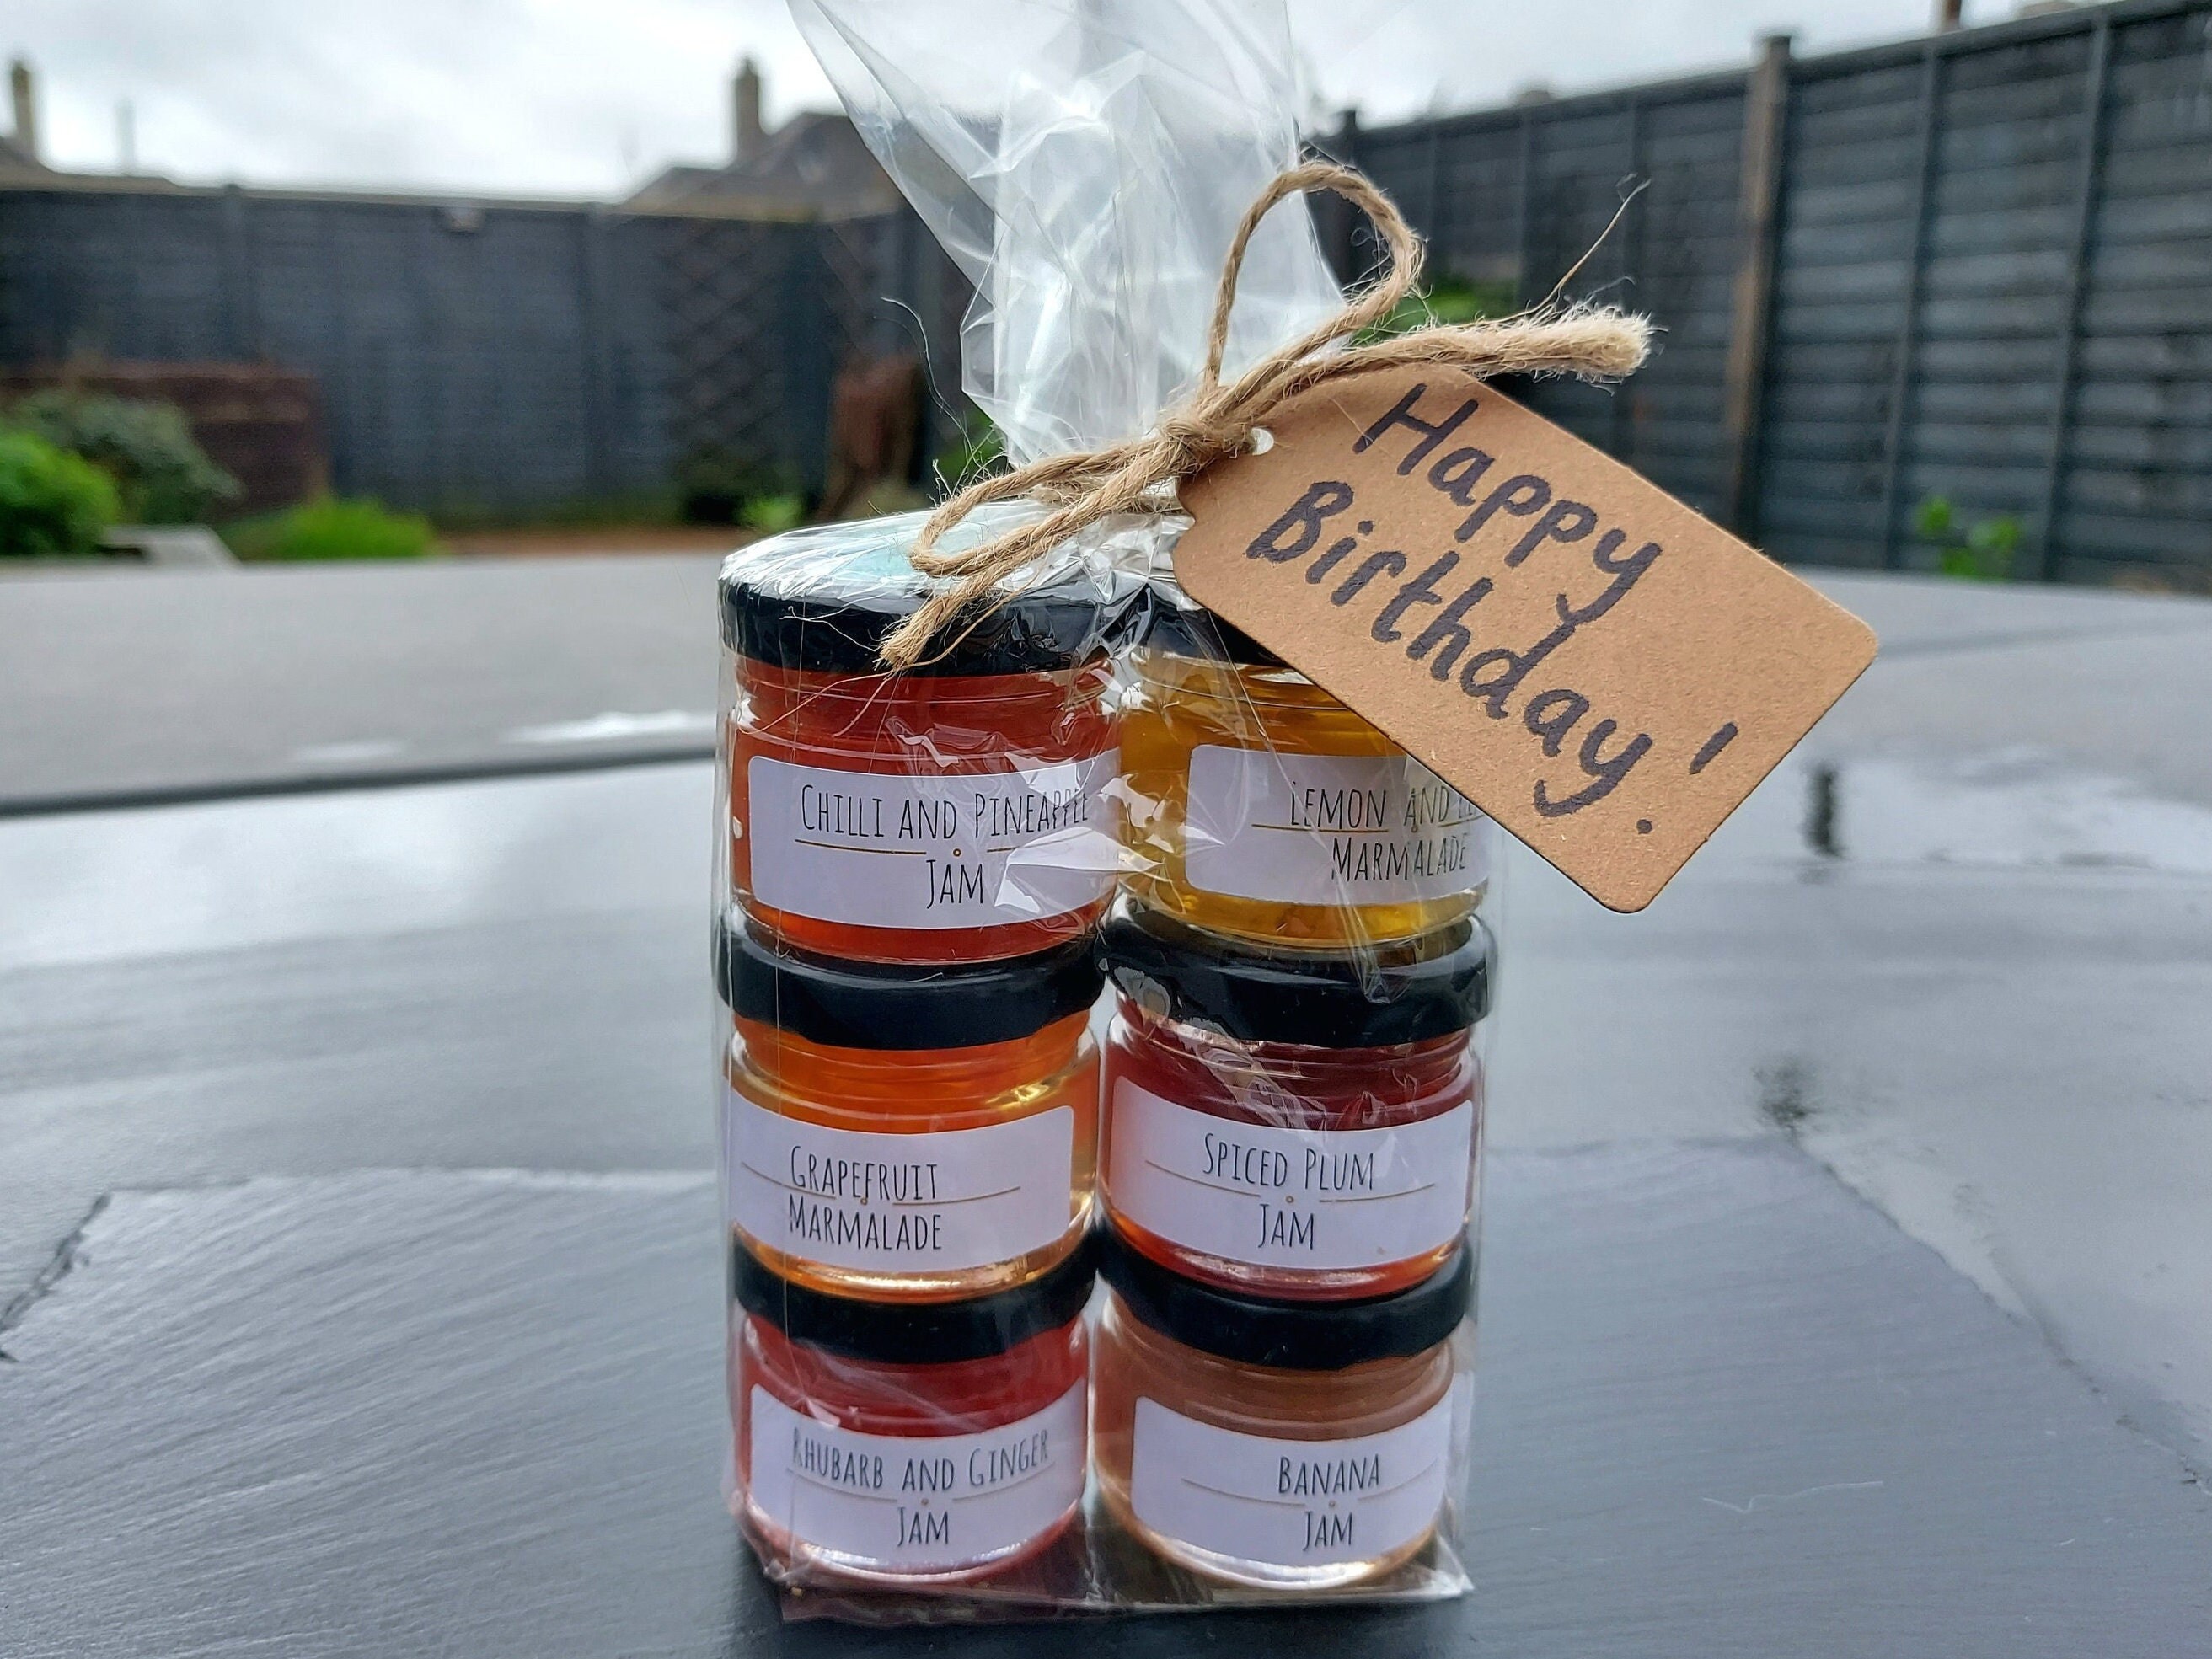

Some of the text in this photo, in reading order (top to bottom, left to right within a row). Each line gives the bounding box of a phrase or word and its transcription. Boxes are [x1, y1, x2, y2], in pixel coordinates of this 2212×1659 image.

[1352, 382, 1663, 623] Happy
[801, 784, 884, 838] CHILLI
[897, 799, 958, 840] AND
[1289, 780, 1386, 830] LEMON
[1403, 785, 1449, 828] AND
[1331, 836, 1469, 881] MARMALADE
[926, 859, 985, 910] JAM
[790, 1145, 938, 1201] GRAPEFRUIT
[1202, 1132, 1374, 1191] SPICED PLUM
[789, 1193, 942, 1250] MARMALADE
[1257, 1203, 1315, 1250] JAM
[792, 1427, 1048, 1492] RHUBARB AND GINGER
[1277, 1453, 1380, 1496] BANANA
[897, 1506, 949, 1548] JAM
[1302, 1510, 1353, 1552] JAM
